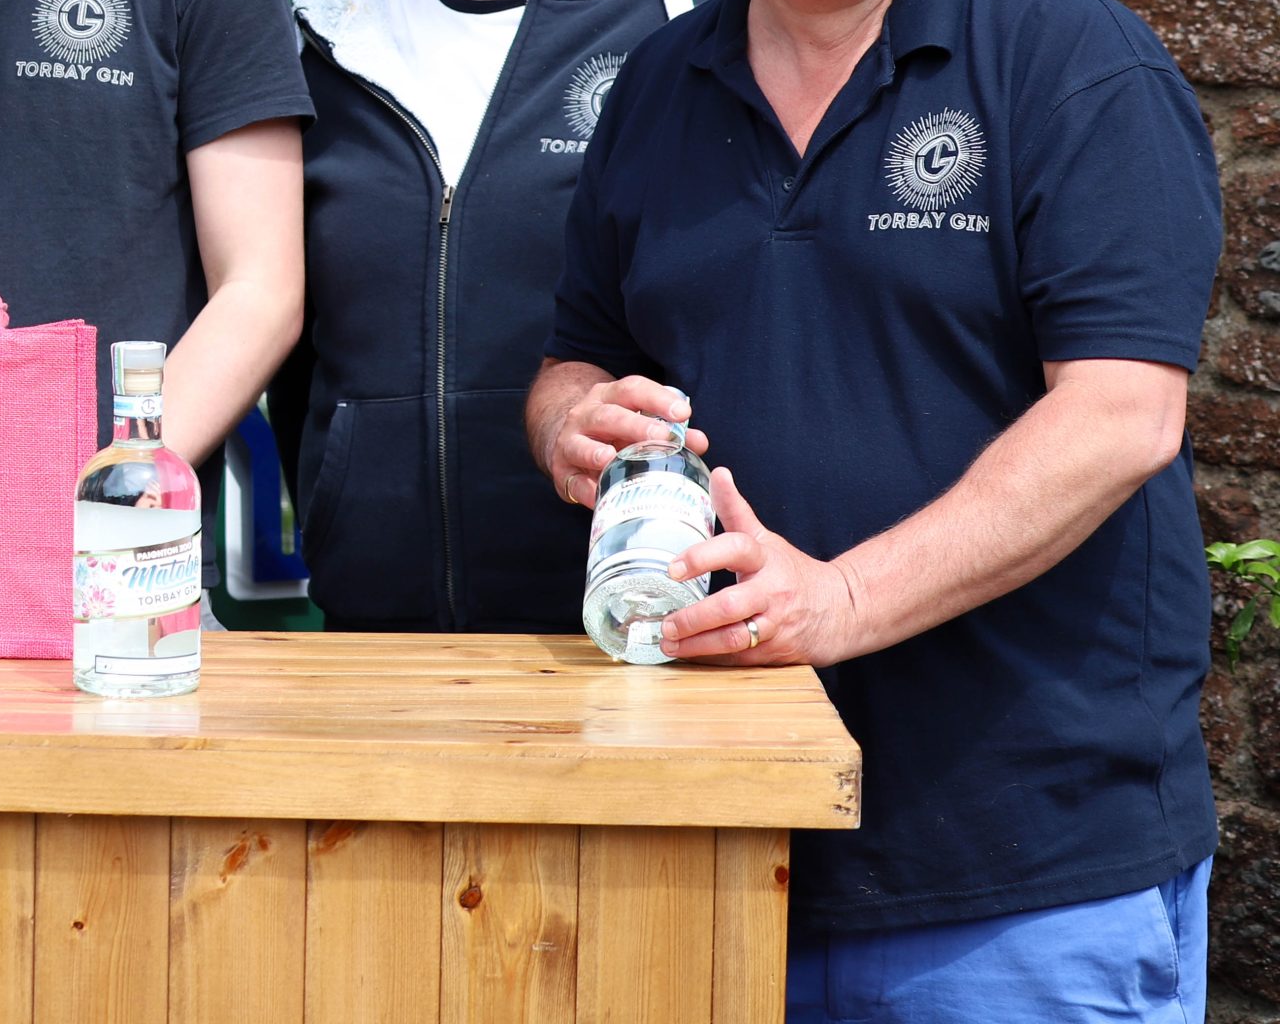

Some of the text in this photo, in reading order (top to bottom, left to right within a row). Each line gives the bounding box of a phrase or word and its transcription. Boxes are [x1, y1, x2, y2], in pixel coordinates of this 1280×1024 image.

[16, 61, 134, 87] TORBAY GIN
[868, 211, 990, 233] TORBAY GIN
[138, 589, 182, 606] TORBAY
